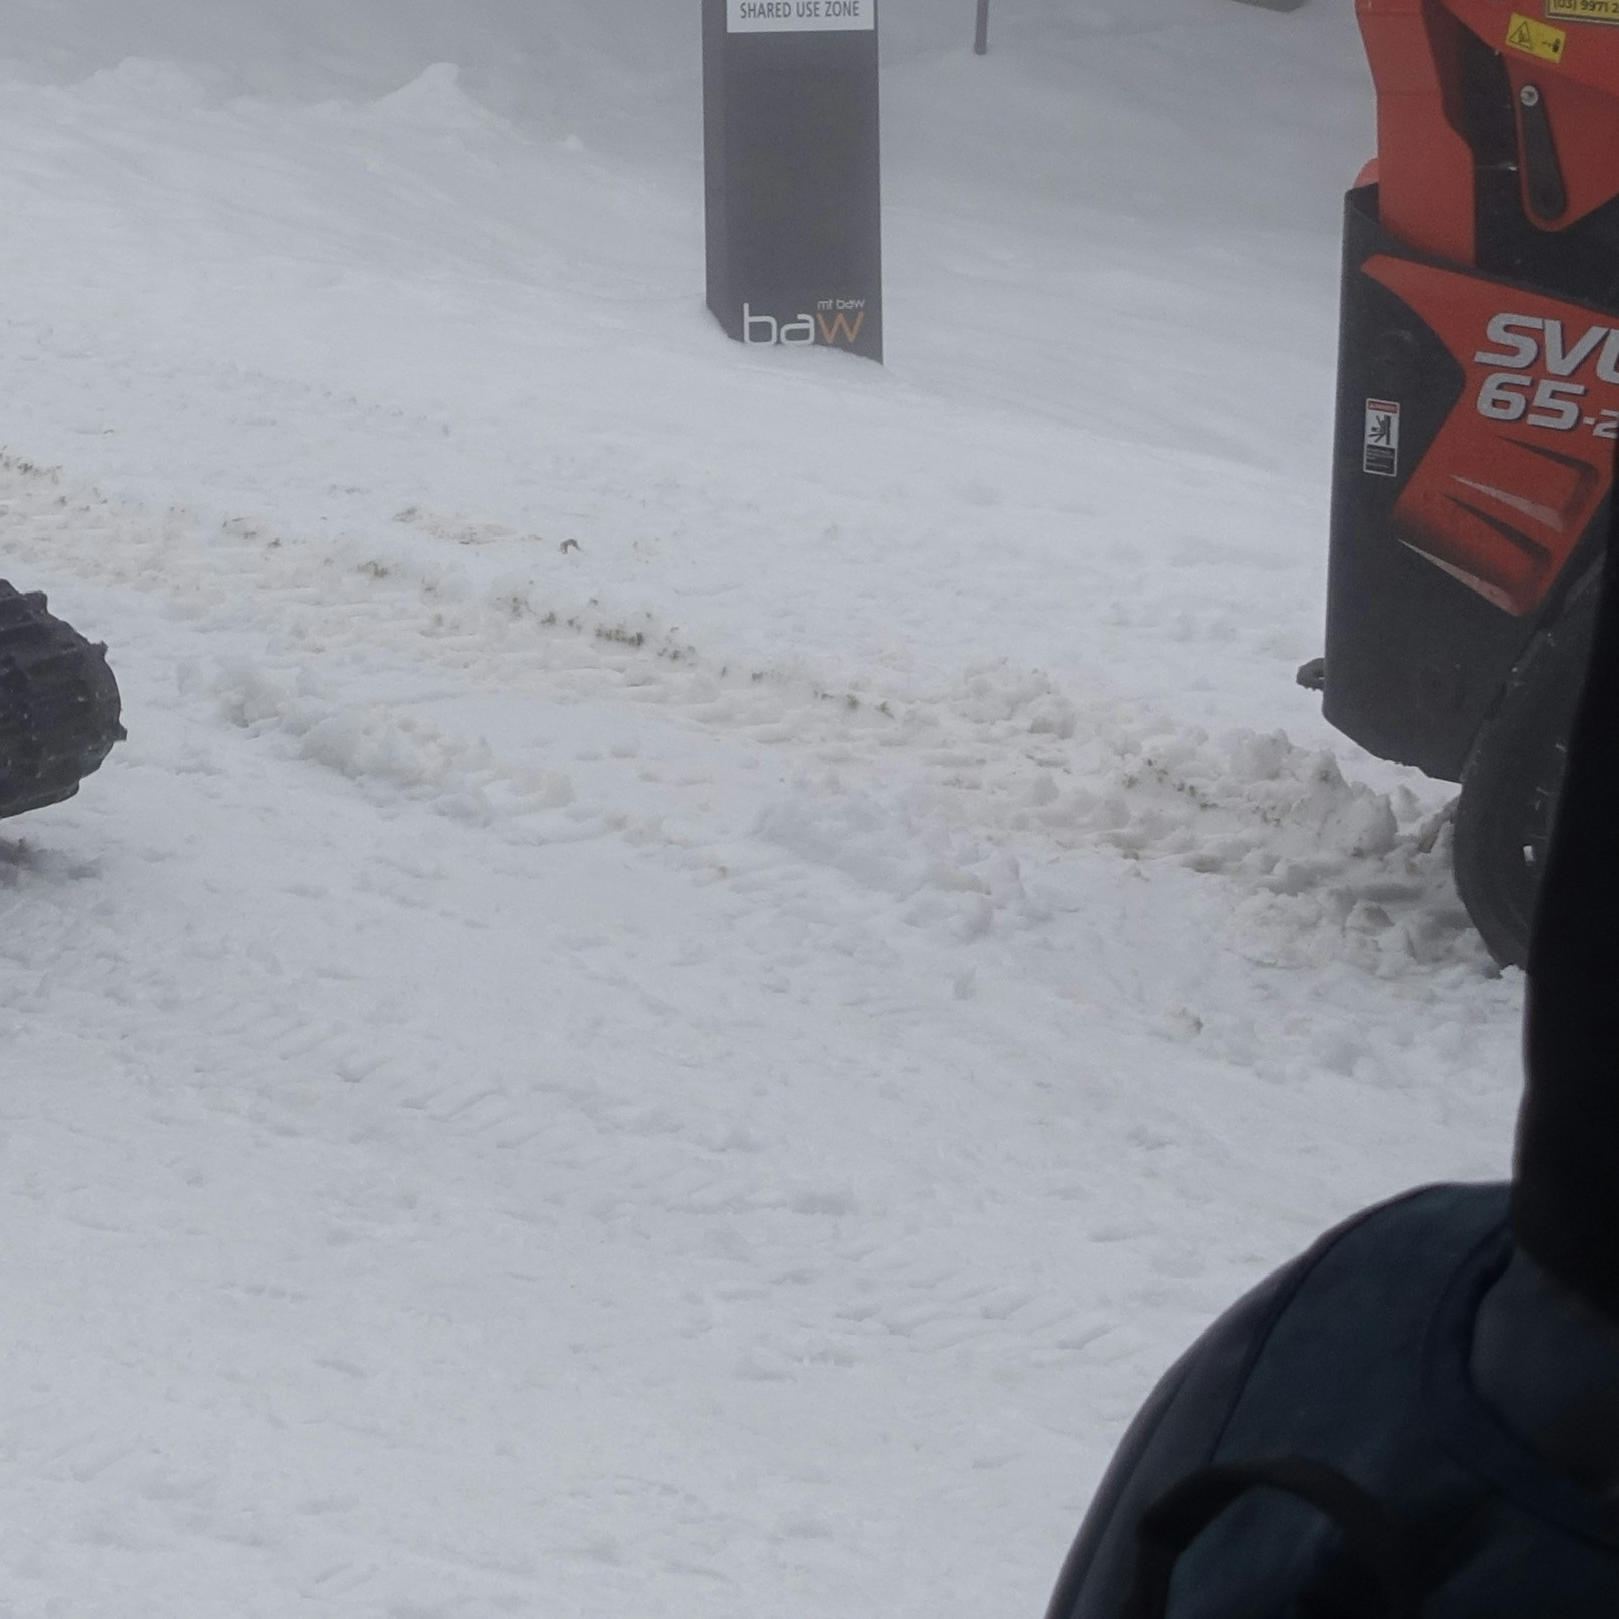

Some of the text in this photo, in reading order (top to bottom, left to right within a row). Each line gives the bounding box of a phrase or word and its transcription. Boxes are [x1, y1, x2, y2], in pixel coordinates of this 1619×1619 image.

[740, 0, 860, 19] SHARED USE ZONE
[743, 302, 865, 346] baw
